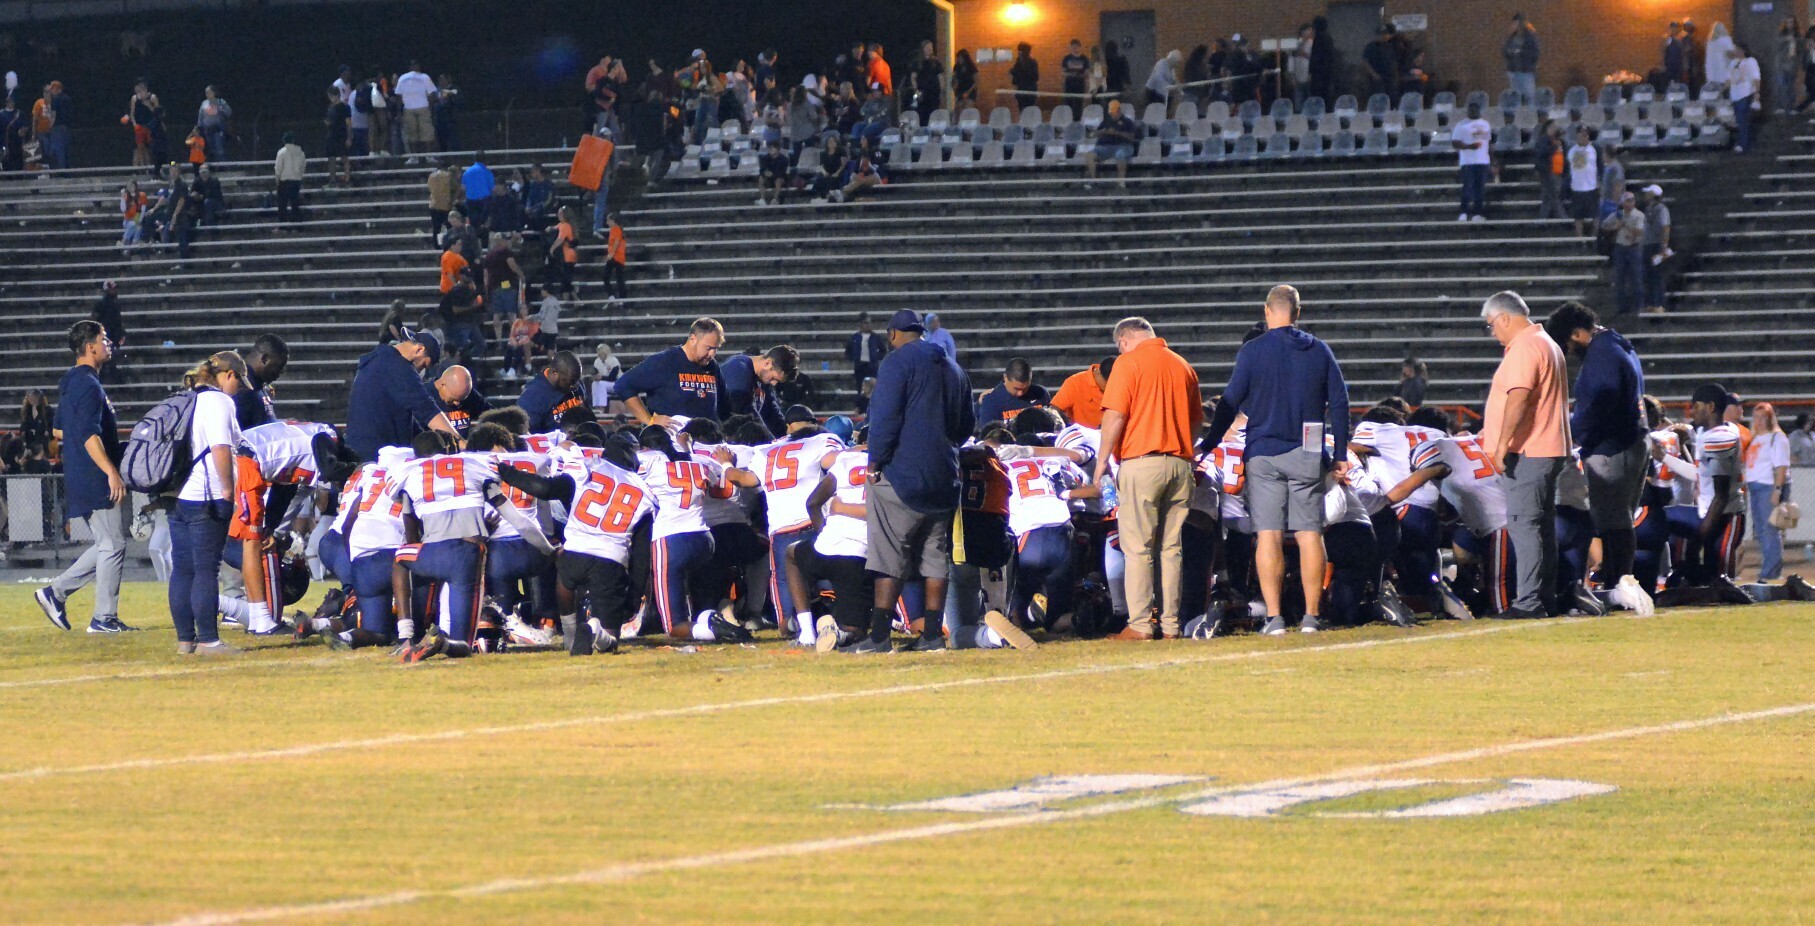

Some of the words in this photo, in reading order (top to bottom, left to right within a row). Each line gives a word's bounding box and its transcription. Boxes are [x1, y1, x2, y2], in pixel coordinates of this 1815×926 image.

[680, 382, 717, 390] FOOTBALL
[421, 457, 466, 502] 19
[765, 443, 804, 492] 15
[1010, 460, 1055, 499] 2
[574, 471, 643, 533] 28
